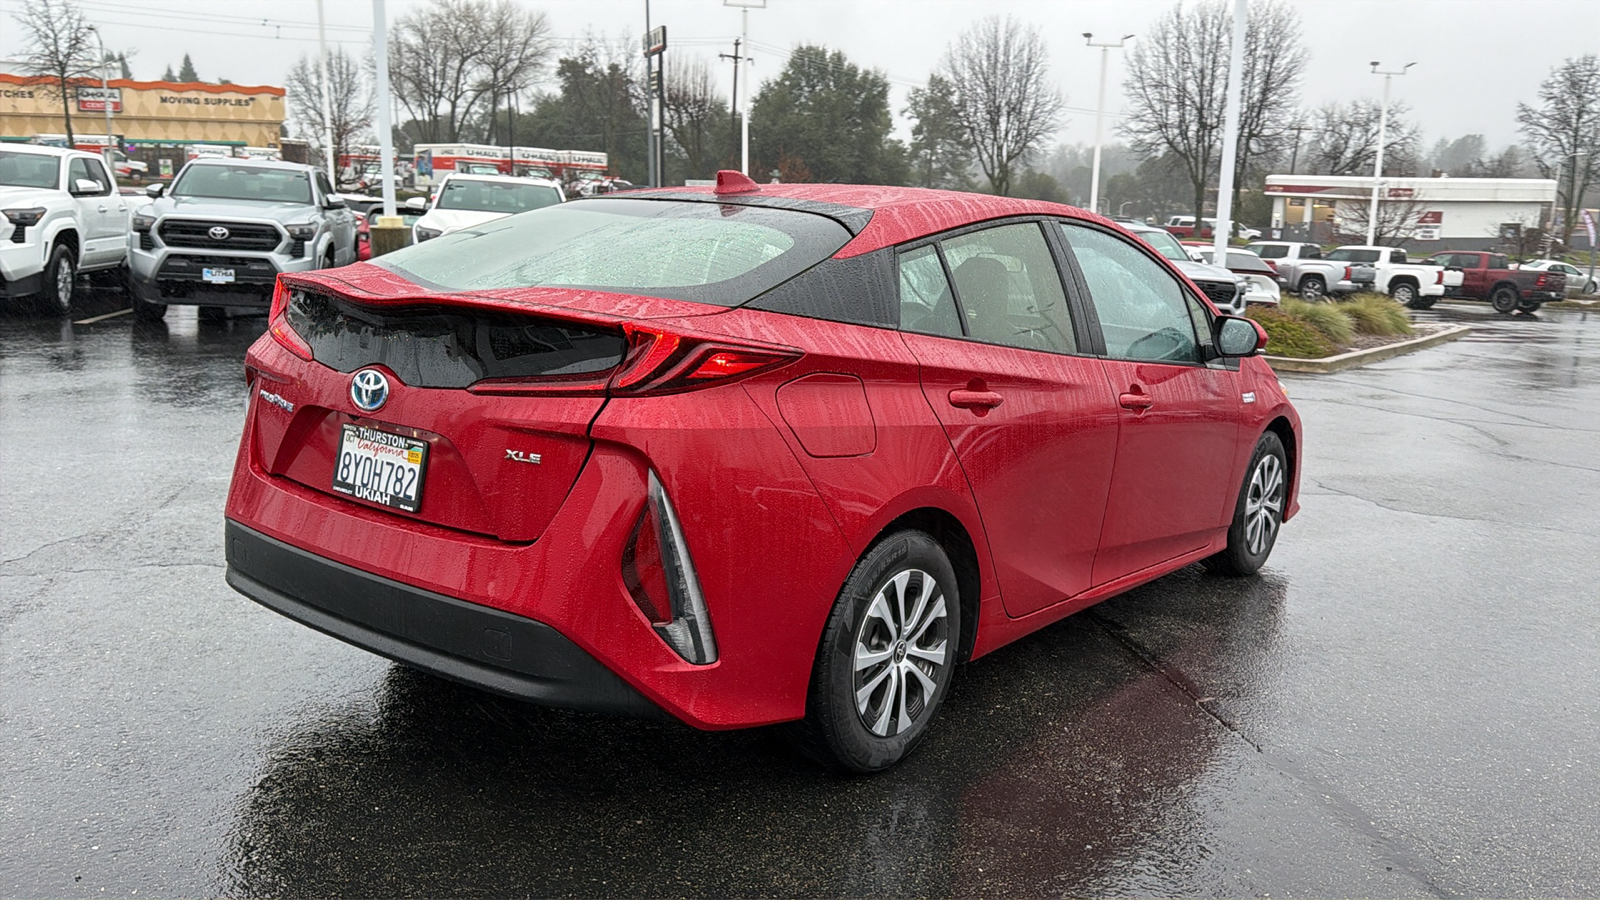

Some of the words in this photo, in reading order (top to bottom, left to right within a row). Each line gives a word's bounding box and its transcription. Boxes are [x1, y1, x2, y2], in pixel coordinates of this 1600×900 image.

[160, 95, 200, 105] MOVING
[203, 97, 250, 107] SUPPLIES
[466, 149, 500, 158] U-HAUL
[521, 152, 555, 162] U-HAUL
[572, 155, 605, 164] U-HAUL
[359, 427, 406, 449] THURSTON
[357, 437, 409, 461] California
[504, 448, 542, 464] XLE
[355, 485, 391, 506] UKIAH
